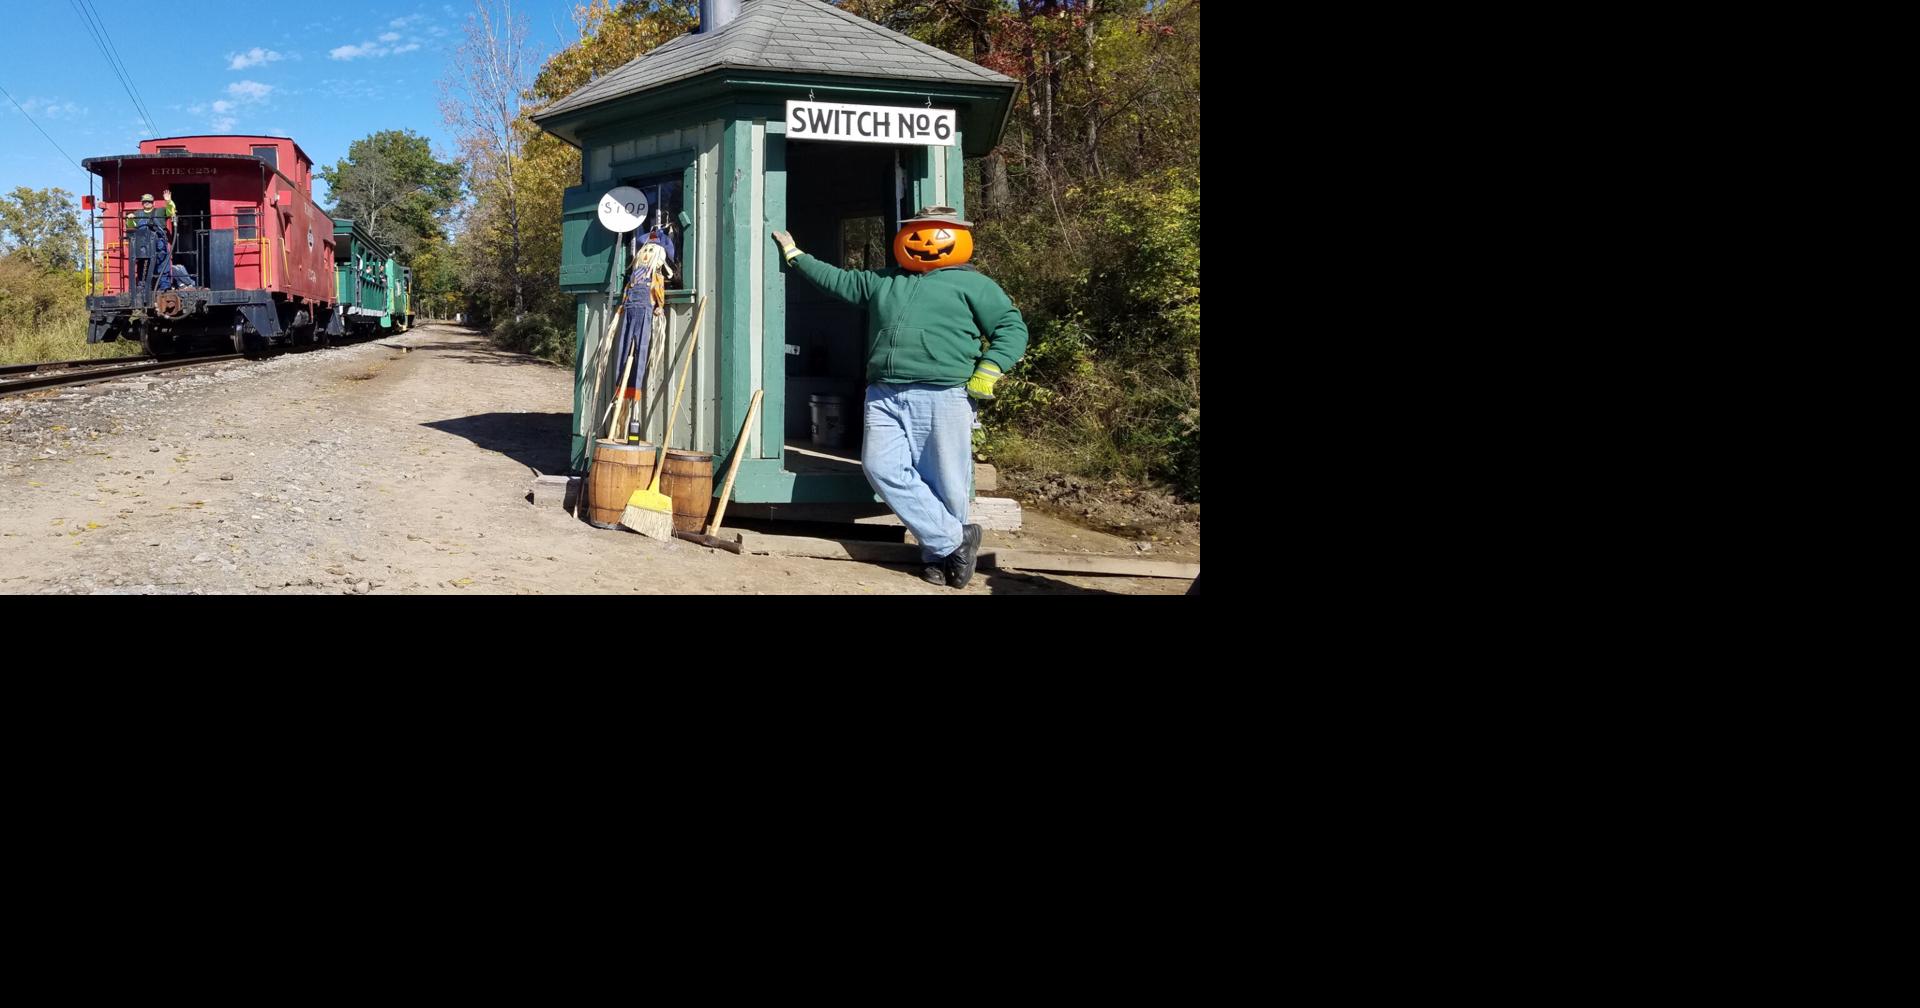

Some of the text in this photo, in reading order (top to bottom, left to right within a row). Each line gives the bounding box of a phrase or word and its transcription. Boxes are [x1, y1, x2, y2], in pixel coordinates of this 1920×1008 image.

[791, 106, 890, 137] SWITCH
[934, 114, 951, 140] 6
[151, 167, 185, 175] ERIE
[603, 201, 646, 214] STOP
